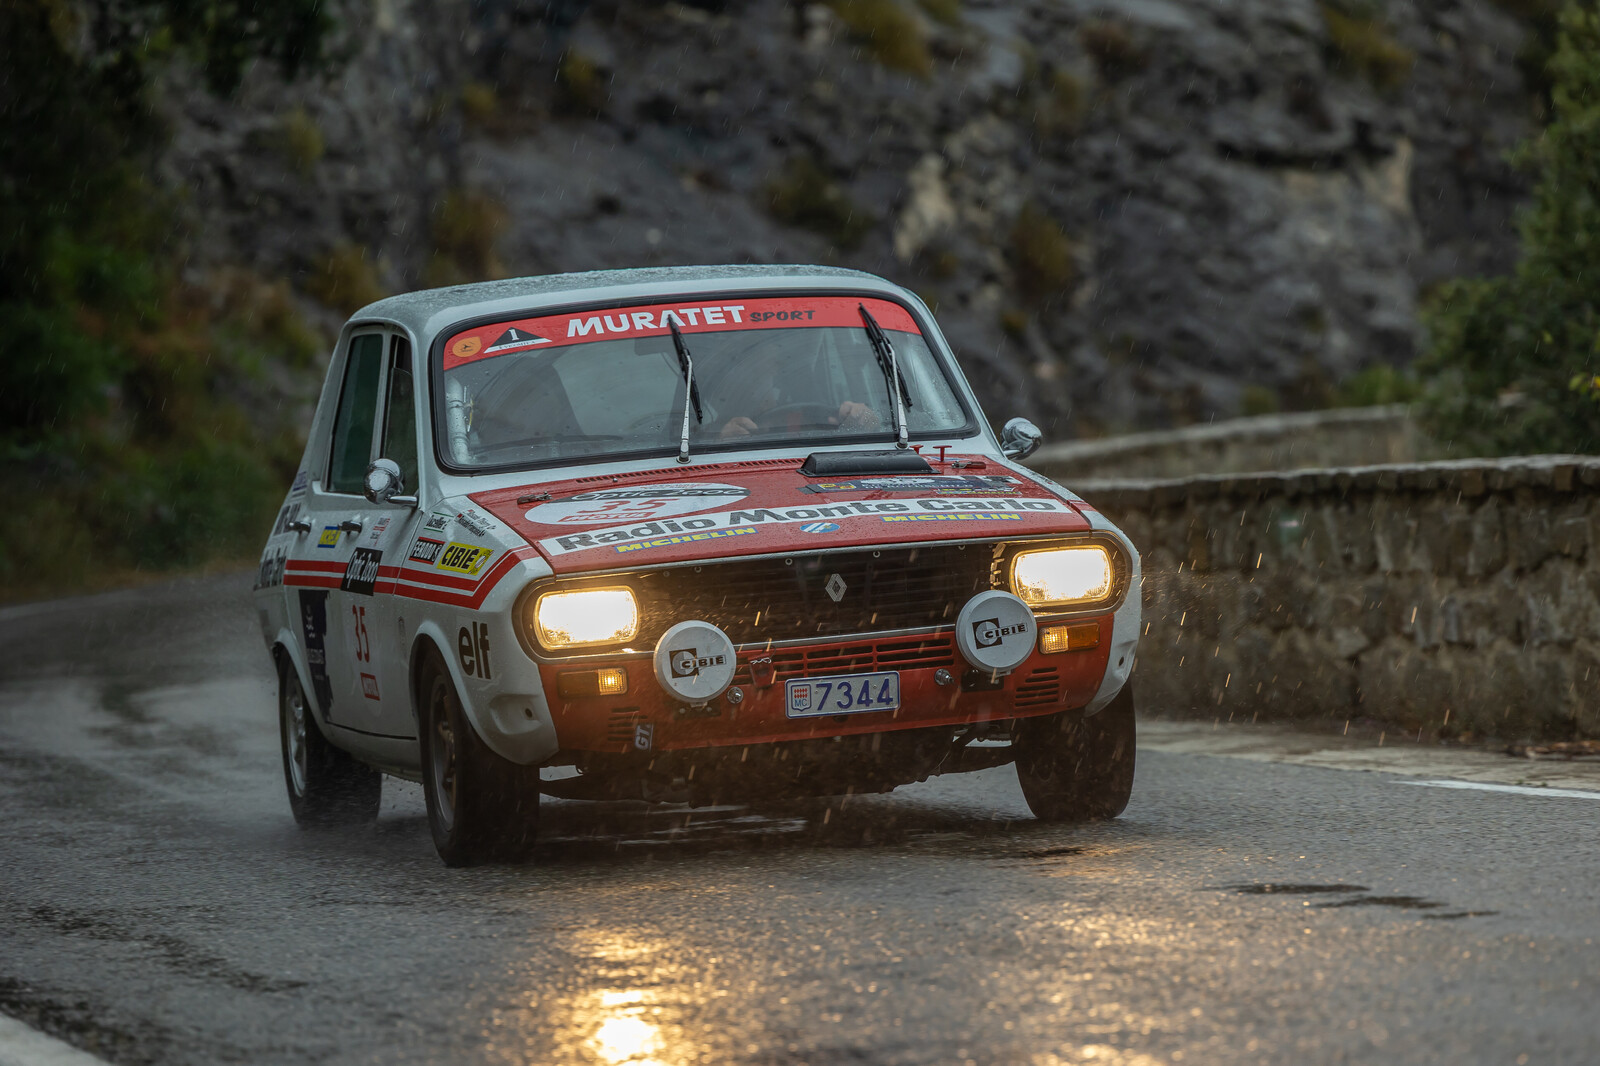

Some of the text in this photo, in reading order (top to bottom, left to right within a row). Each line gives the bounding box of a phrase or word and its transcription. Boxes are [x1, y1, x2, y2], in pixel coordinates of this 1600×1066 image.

[567, 305, 816, 337] MURATET SPORT
[576, 499, 679, 514] 35
[882, 513, 1020, 522] MICHELIN
[555, 498, 1057, 550] Radio Monte Carlo
[617, 527, 756, 553] MICHELIN
[352, 604, 370, 663] 35
[458, 621, 491, 680] elf
[794, 699, 808, 707] MC
[815, 678, 894, 711] 7344
